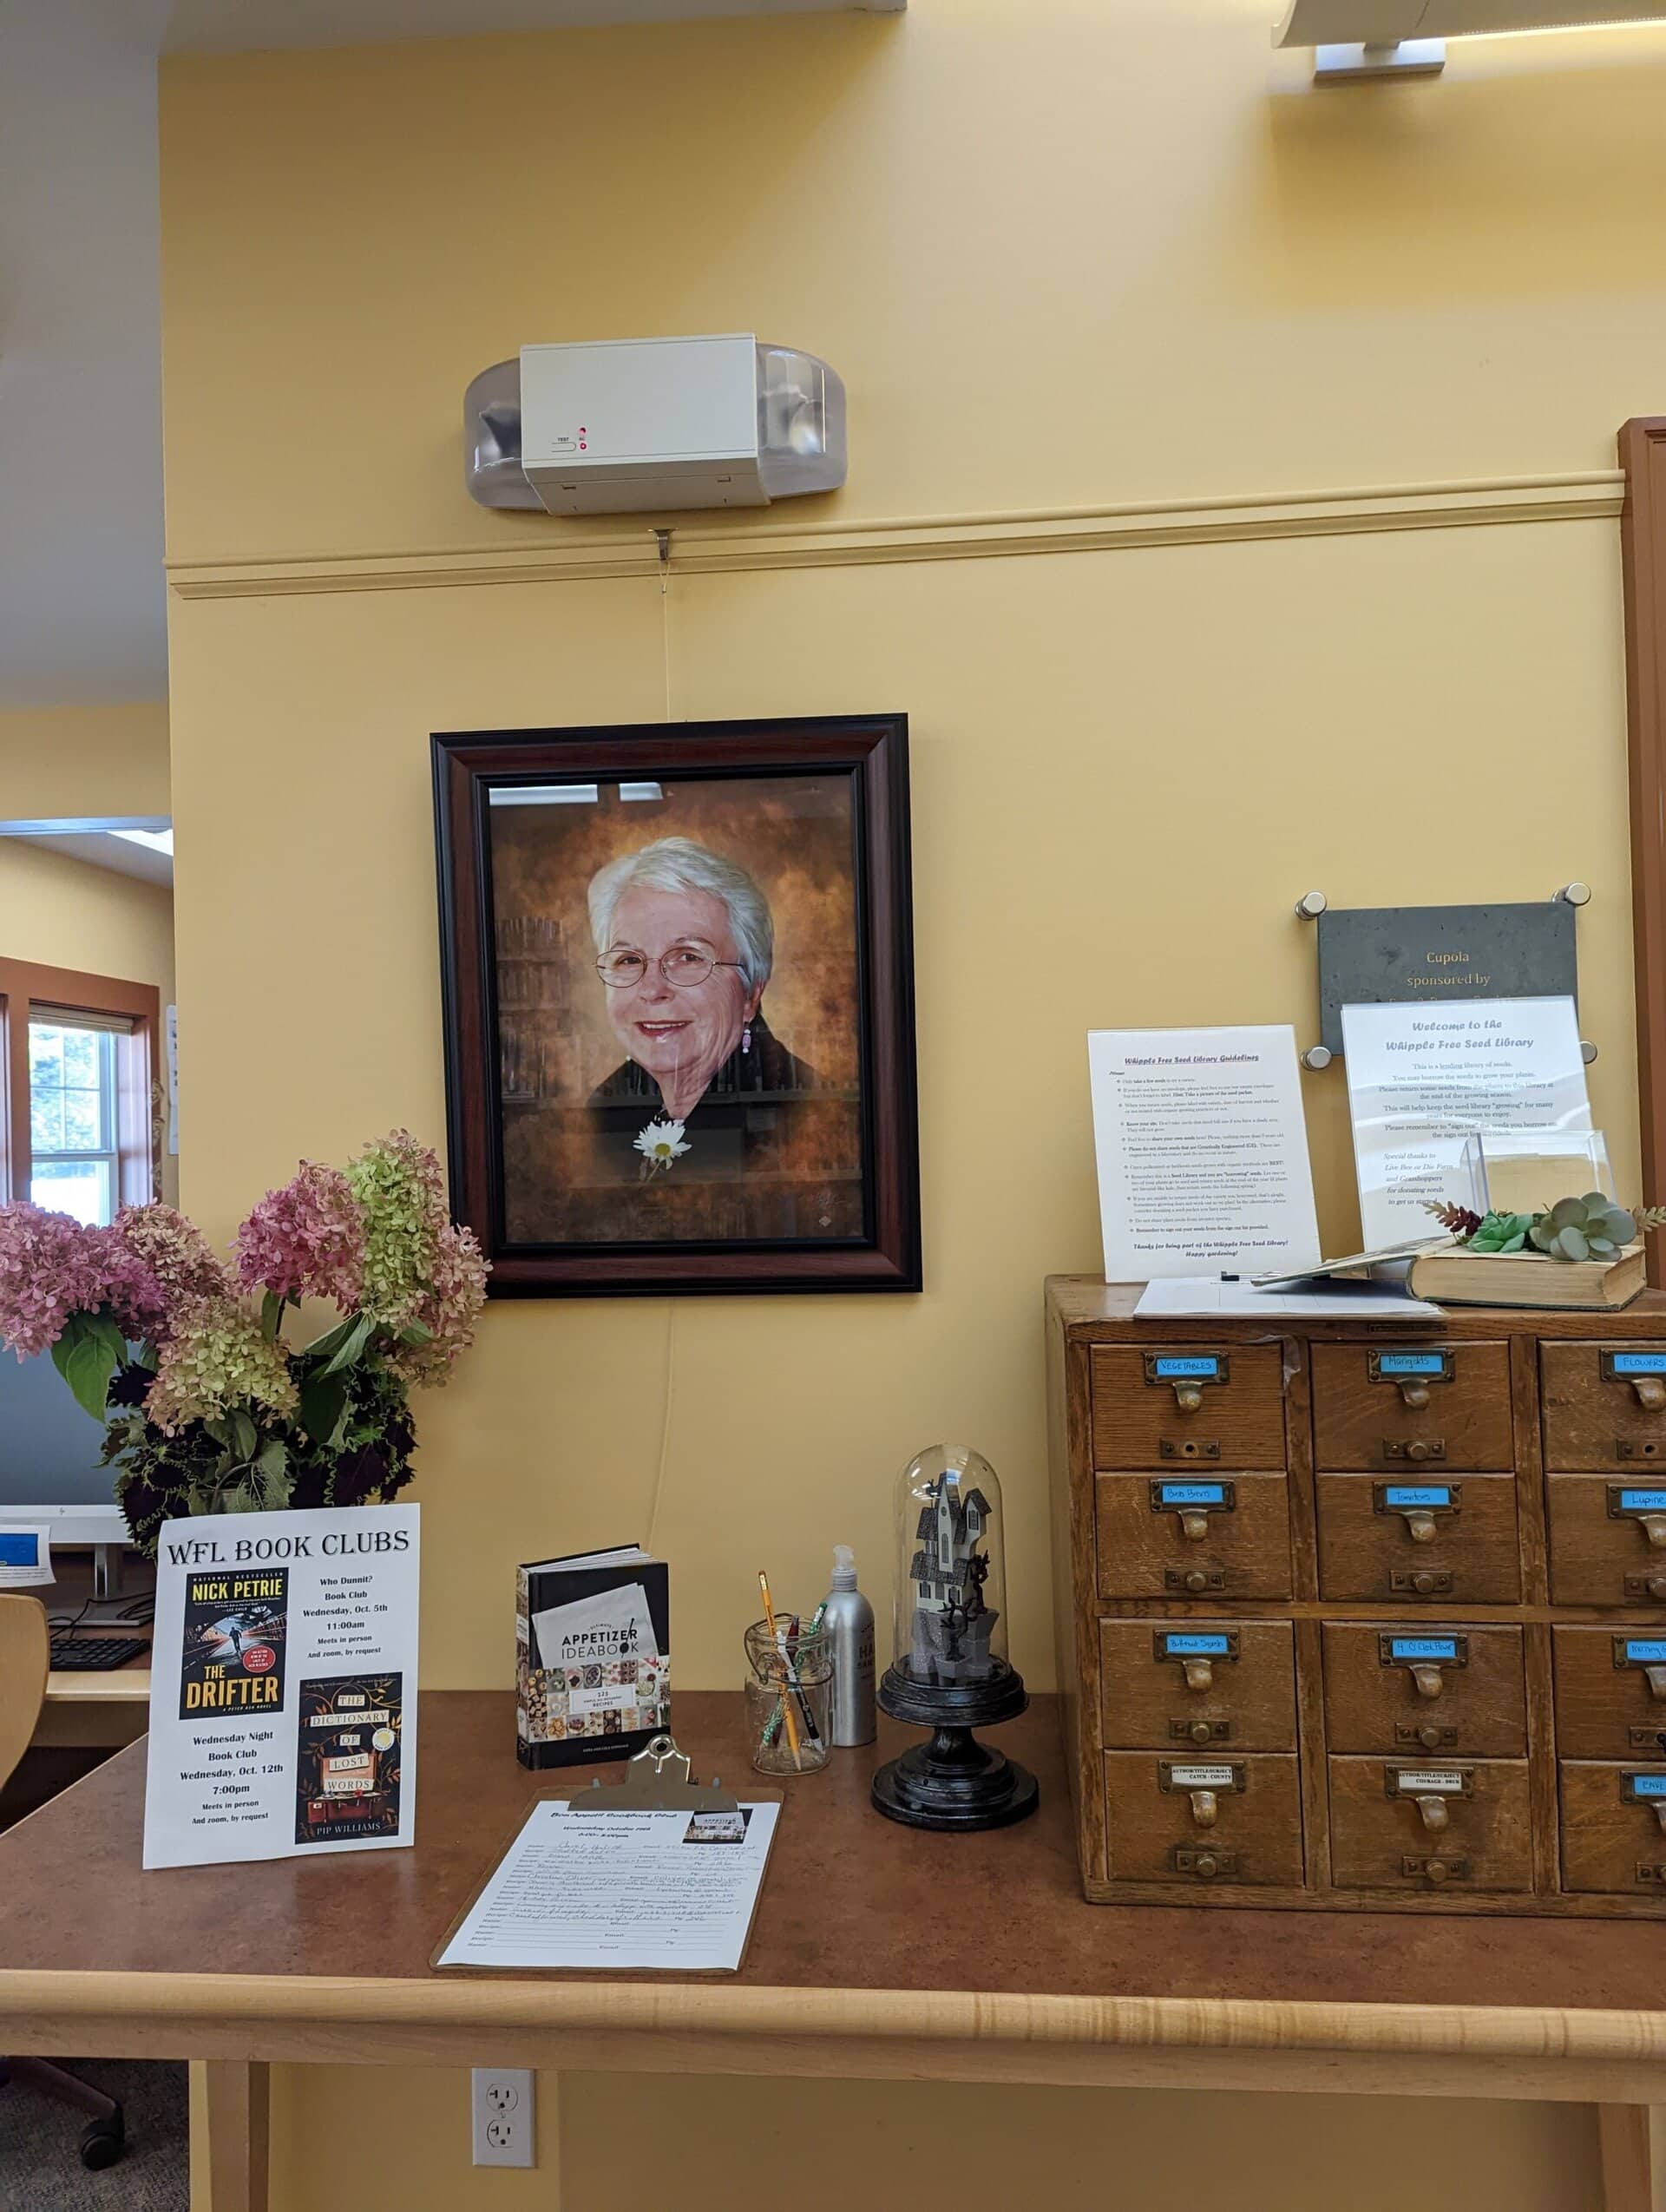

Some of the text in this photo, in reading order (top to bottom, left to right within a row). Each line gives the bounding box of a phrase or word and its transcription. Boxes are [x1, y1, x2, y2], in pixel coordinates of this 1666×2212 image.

[1427, 950, 1469, 965] Cupola
[1407, 972, 1491, 988] sponsored by
[1413, 1019, 1502, 1031] Welcome to the
[1386, 1037, 1534, 1052] Whipple Free Seed Library
[1125, 1056, 1156, 1066] Whipple
[1158, 1055, 1172, 1064] Free
[1220, 1053, 1259, 1062] Guidelines
[1160, 1360, 1212, 1369] VEGETABLES
[167, 1530, 410, 1565] WFL BOOK CLUBS
[320, 1575, 373, 1586] Who Dunnit?
[193, 1579, 283, 1601] NICK PETRIE
[325, 1591, 368, 1601] Book Club
[354, 1605, 371, 1613] Oct.
[373, 1604, 388, 1612] 5th
[326, 1620, 365, 1631] 11:00am
[348, 1635, 372, 1644] person
[561, 1629, 638, 1646] APPETIZER
[355, 1647, 381, 1656] request
[561, 1641, 639, 1659] IDEABOOK
[204, 1664, 226, 1679] THE
[187, 1677, 279, 1709] DRIFTER
[339, 1696, 364, 1706] THE
[312, 1711, 388, 1726] DICTIONARY
[193, 1731, 273, 1746] Wednesday Night
[342, 1735, 359, 1745] OF
[208, 1749, 258, 1762] Book Club
[334, 1756, 365, 1769] LOST
[180, 1764, 284, 1781] Wednesday, Oct. 12th
[213, 1785, 250, 1795] 7:00pm
[327, 1779, 370, 1790] WORDS
[234, 1800, 259, 1809] person
[241, 1812, 269, 1821] request
[317, 1821, 381, 1835] PIP WILLIAMS
